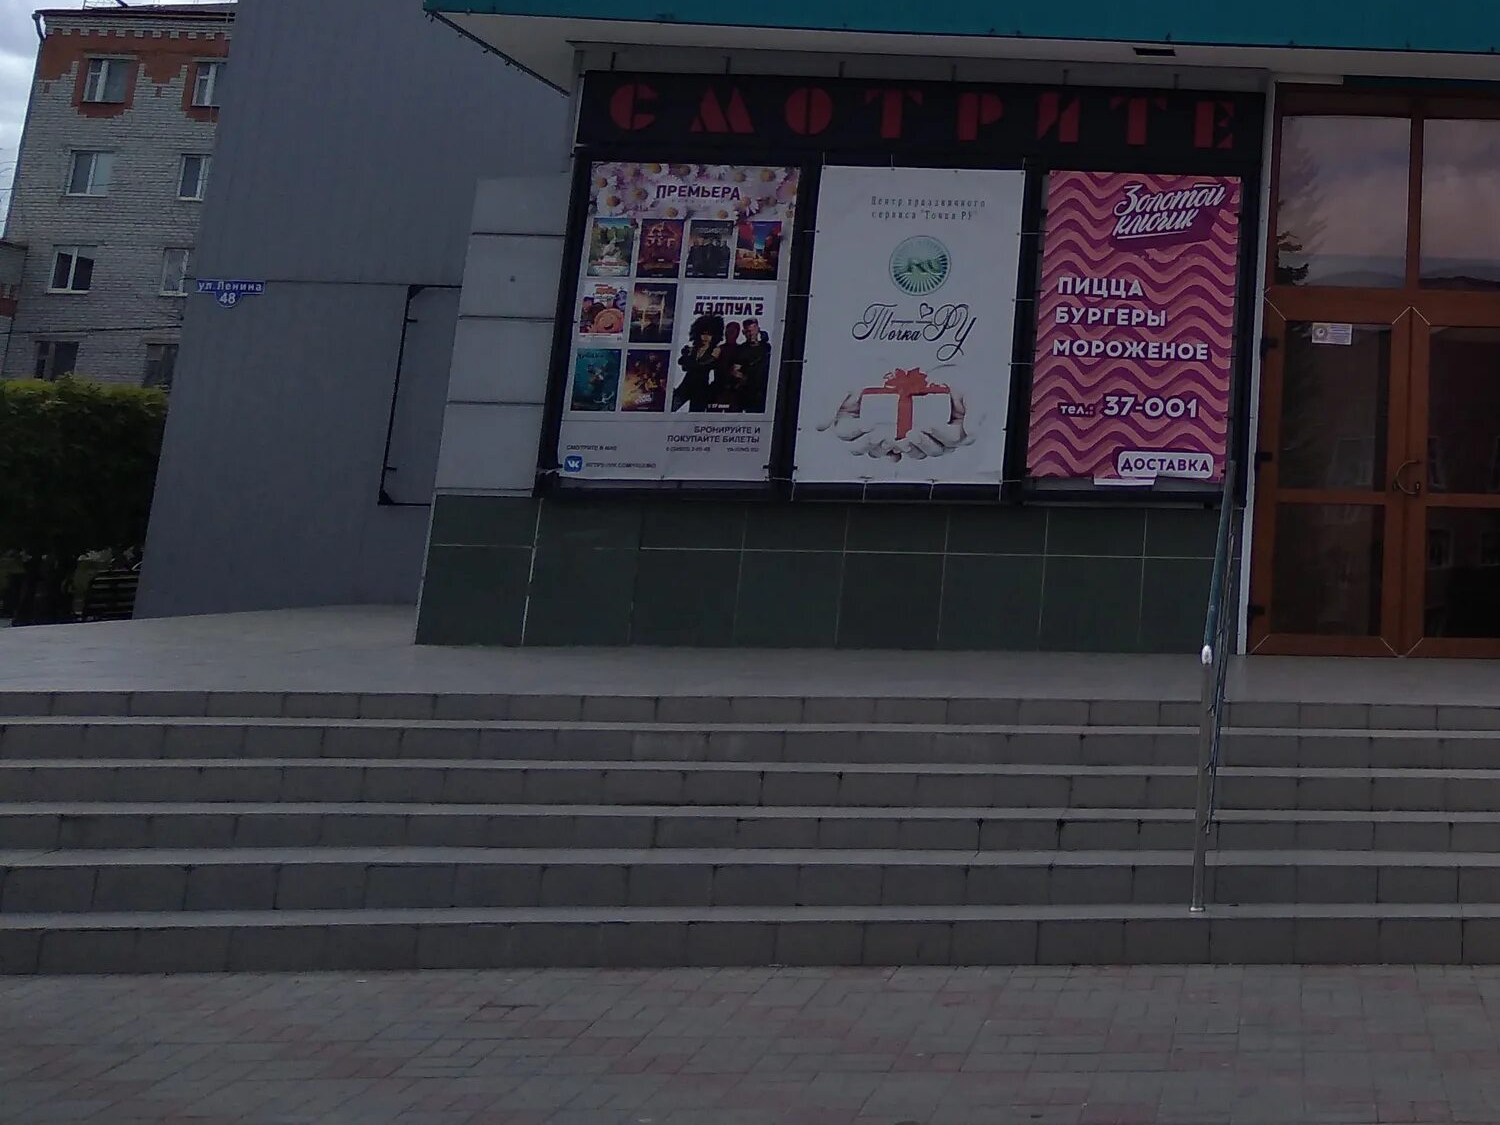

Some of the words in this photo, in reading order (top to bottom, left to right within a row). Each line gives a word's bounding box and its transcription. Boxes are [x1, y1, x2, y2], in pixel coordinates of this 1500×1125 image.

[608, 80, 1236, 150] СМОТРИТЕ
[655, 183, 741, 201] ПРЕМЬЕРА
[1113, 181, 1227, 217] Золотой
[1112, 206, 1200, 238] ключик
[217, 280, 263, 293] Ленина
[1057, 276, 1145, 299] ПИЦЦА
[219, 293, 237, 305] 48
[693, 302, 753, 316] ДЭДПУЛ
[754, 303, 764, 316] 2
[852, 303, 921, 341] Точка
[1055, 306, 1167, 328] БУРГЕРЫ
[1053, 339, 1209, 361] МОРОЖЕНОЕ
[1102, 395, 1200, 419] 37-001
[666, 434, 721, 444] ПОКУПАЙТЕ
[722, 435, 761, 444] БИЛЕТЫ
[693, 425, 753, 435] БРОНИРУЙТЕ
[754, 426, 761, 435] И
[1120, 456, 1211, 473] ДОСТАВКА
